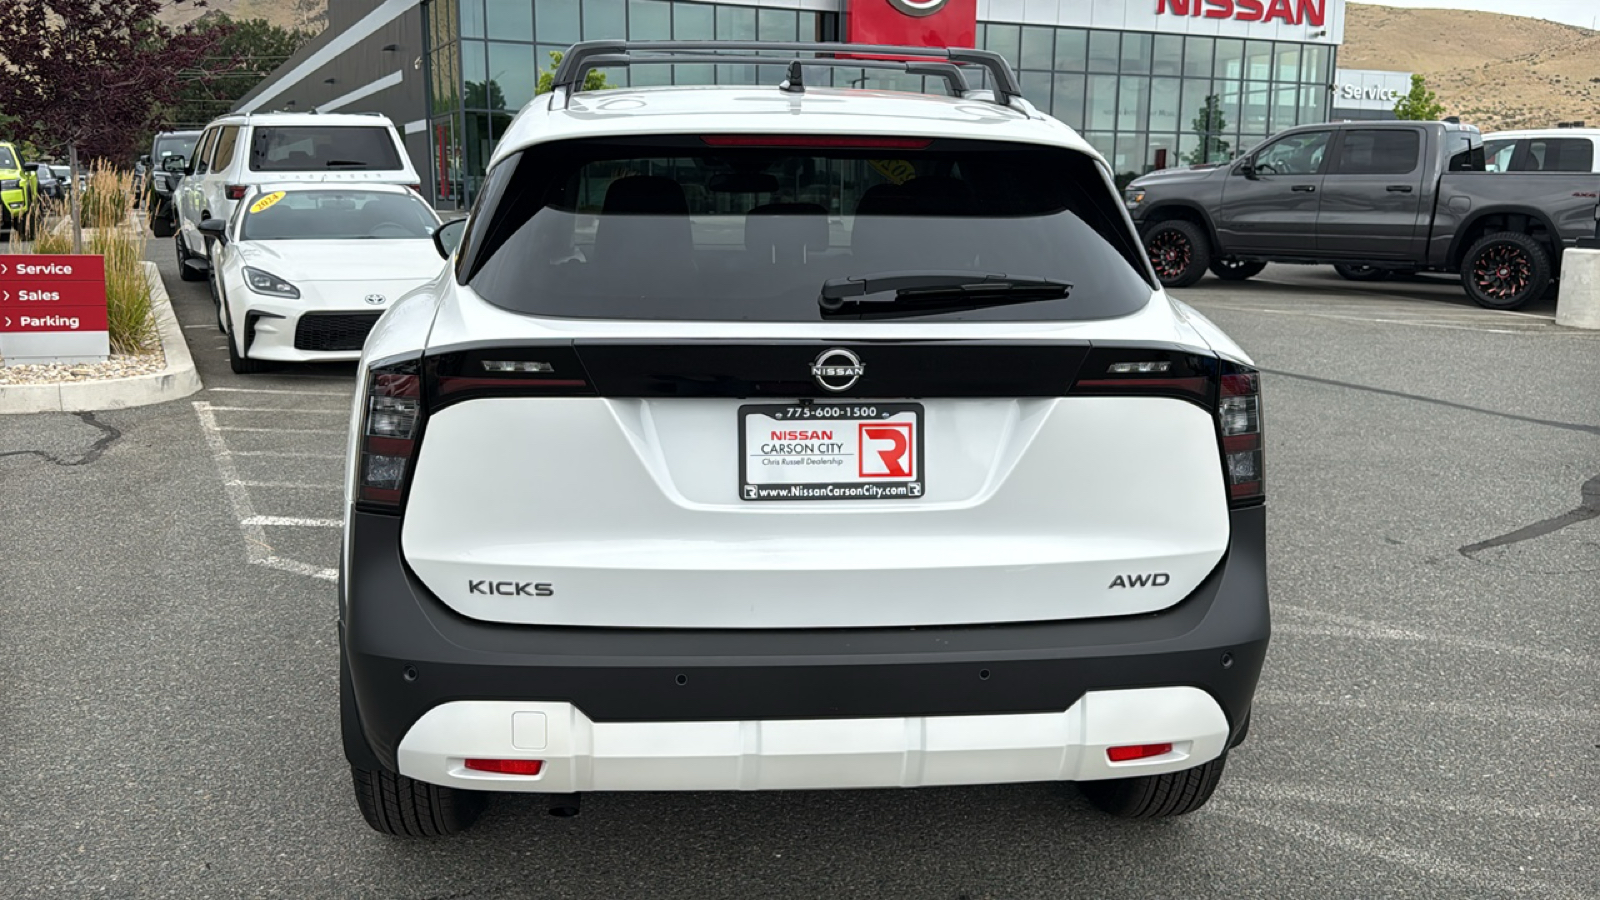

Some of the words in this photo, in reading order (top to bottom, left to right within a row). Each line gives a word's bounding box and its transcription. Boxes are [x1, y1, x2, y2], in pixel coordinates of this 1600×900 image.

[1157, 0, 1326, 26] NISSAN
[1342, 84, 1396, 100] Service
[16, 262, 72, 275] Service
[18, 289, 60, 301] Sales
[20, 315, 80, 329] Parking
[812, 367, 864, 375] NISSAN
[786, 407, 877, 418] 775-600-1500
[770, 431, 833, 441] NISSAN
[760, 444, 815, 455] CARSON
[817, 443, 844, 454] CITY
[761, 458, 779, 466] Chris
[781, 458, 805, 466] Russell
[806, 457, 844, 467] Dealership
[759, 484, 907, 498] www.NissanCarsonCity.com
[1108, 573, 1170, 590] AWD
[468, 580, 555, 597] KICKS
